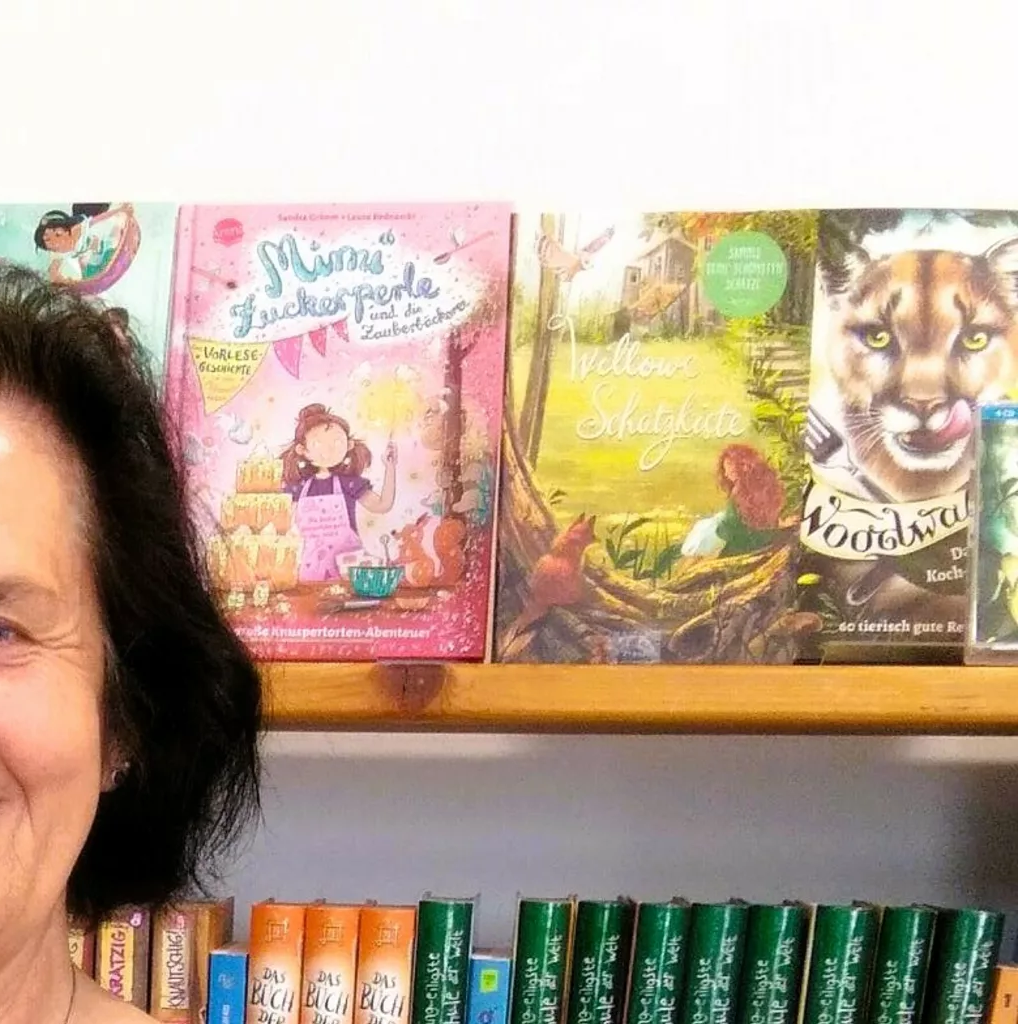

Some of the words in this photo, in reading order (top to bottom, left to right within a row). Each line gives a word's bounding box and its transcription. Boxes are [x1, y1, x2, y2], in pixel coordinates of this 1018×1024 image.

[230, 261, 440, 337] Zuckerperle
[369, 305, 396, 320] und
[405, 302, 422, 318] die
[858, 620, 910, 634] tierisch
[913, 621, 943, 635] gute
[449, 930, 463, 958] Welt
[166, 929, 185, 1008] KNAUTSCHIG!
[264, 967, 286, 984] DAS
[318, 970, 341, 988] DAS
[374, 972, 396, 990] DAS
[251, 978, 295, 1015] BUCH
[306, 980, 350, 1017] BUCH
[361, 982, 405, 1019] BUCH
